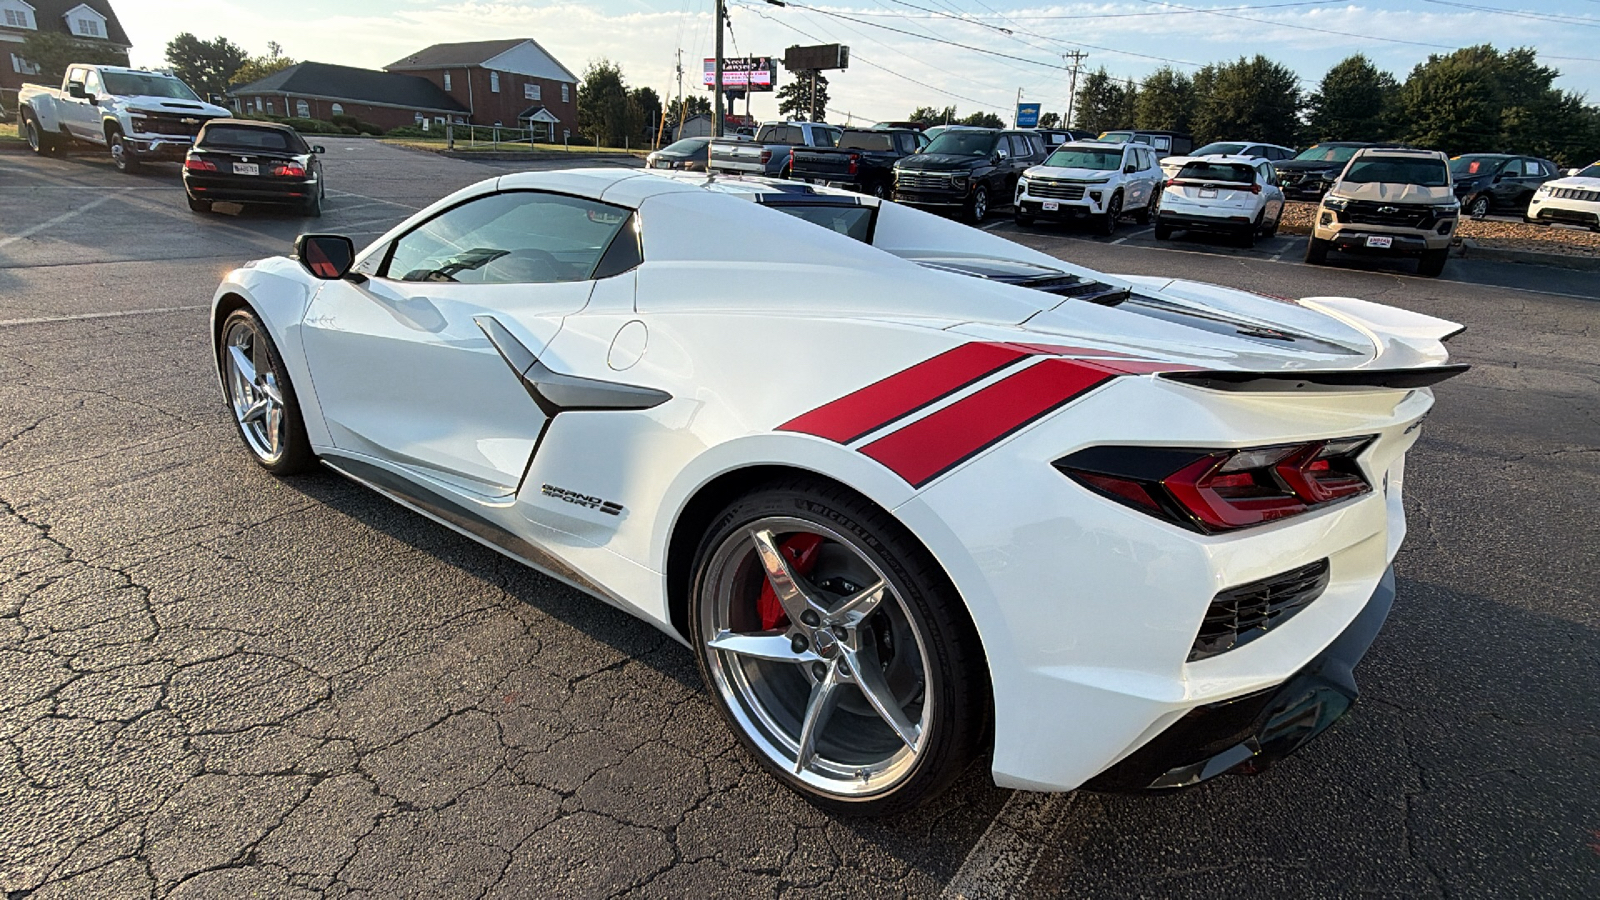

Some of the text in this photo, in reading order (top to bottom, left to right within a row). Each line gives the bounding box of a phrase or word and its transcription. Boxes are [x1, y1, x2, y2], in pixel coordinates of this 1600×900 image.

[541, 483, 602, 504] GRAND
[541, 489, 600, 509] SPORT
[811, 503, 879, 547] MICHELIN
[880, 550, 900, 570] PILOT
[899, 572, 921, 598] SPORT
